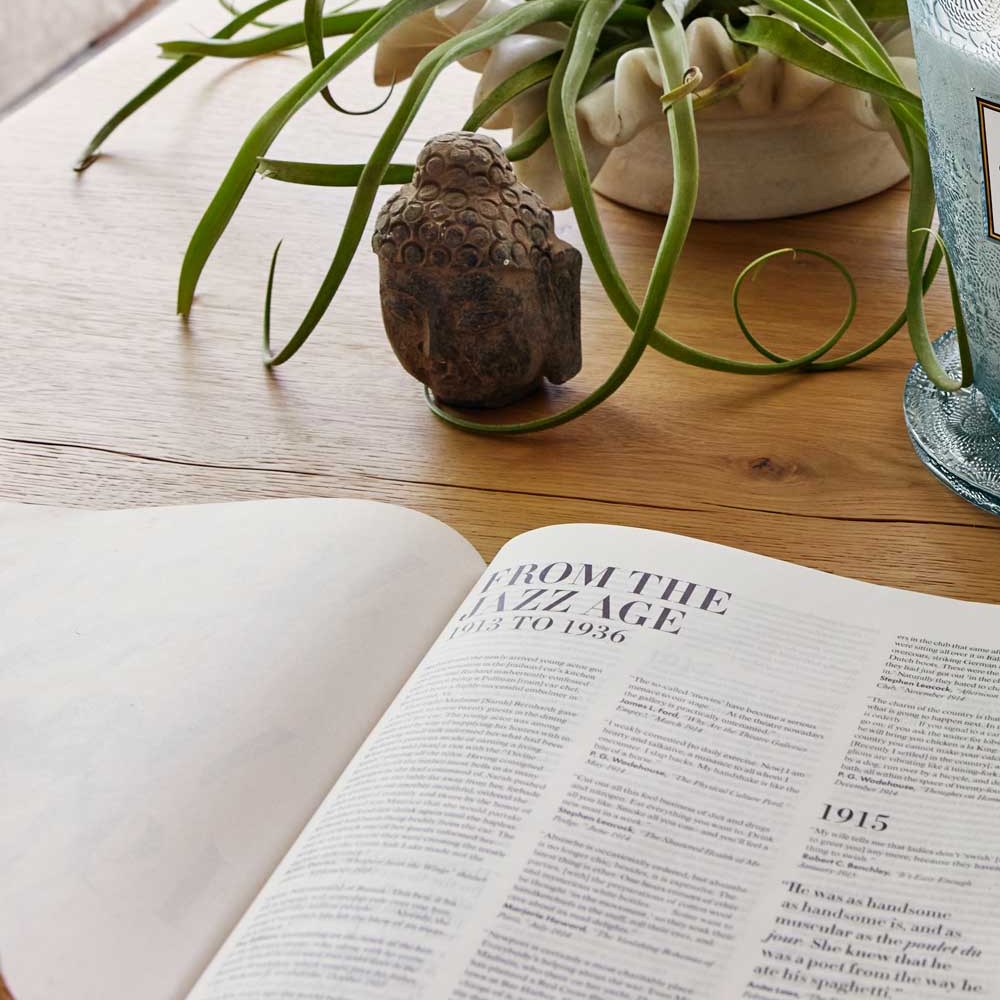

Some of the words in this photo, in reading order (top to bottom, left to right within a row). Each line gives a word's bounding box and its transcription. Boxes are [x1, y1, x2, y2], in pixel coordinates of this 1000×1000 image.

[480, 562, 617, 594] FROM
[627, 570, 733, 616] THE
[458, 588, 580, 622] JAZZ
[582, 594, 687, 635] AGE
[449, 618, 503, 640] 1913
[512, 616, 553, 632] TO
[560, 620, 631, 644] 1936
[818, 804, 890, 832] 1915
[780, 900, 797, 910] as
[801, 900, 885, 926] handsome
[911, 922, 942, 935] and
[945, 928, 961, 937] as
[813, 890, 843, 902] was
[846, 896, 862, 906] as
[866, 895, 951, 919] handsome
[775, 916, 851, 938] muscular
[856, 931, 871, 941] as
[876, 930, 901, 946] the
[904, 939, 958, 954] poulet
[960, 943, 981, 957] du
[808, 936, 840, 953] She
[845, 942, 889, 961] knew
[894, 950, 927, 966] that
[930, 956, 951, 970] he
[753, 963, 777, 977] ate
[782, 967, 806, 983] his
[761, 949, 791, 962] was
[806, 958, 845, 972] poet
[848, 961, 889, 979] from
[894, 969, 920, 984] the
[925, 978, 956, 994] way
[961, 978, 982, 992] he
